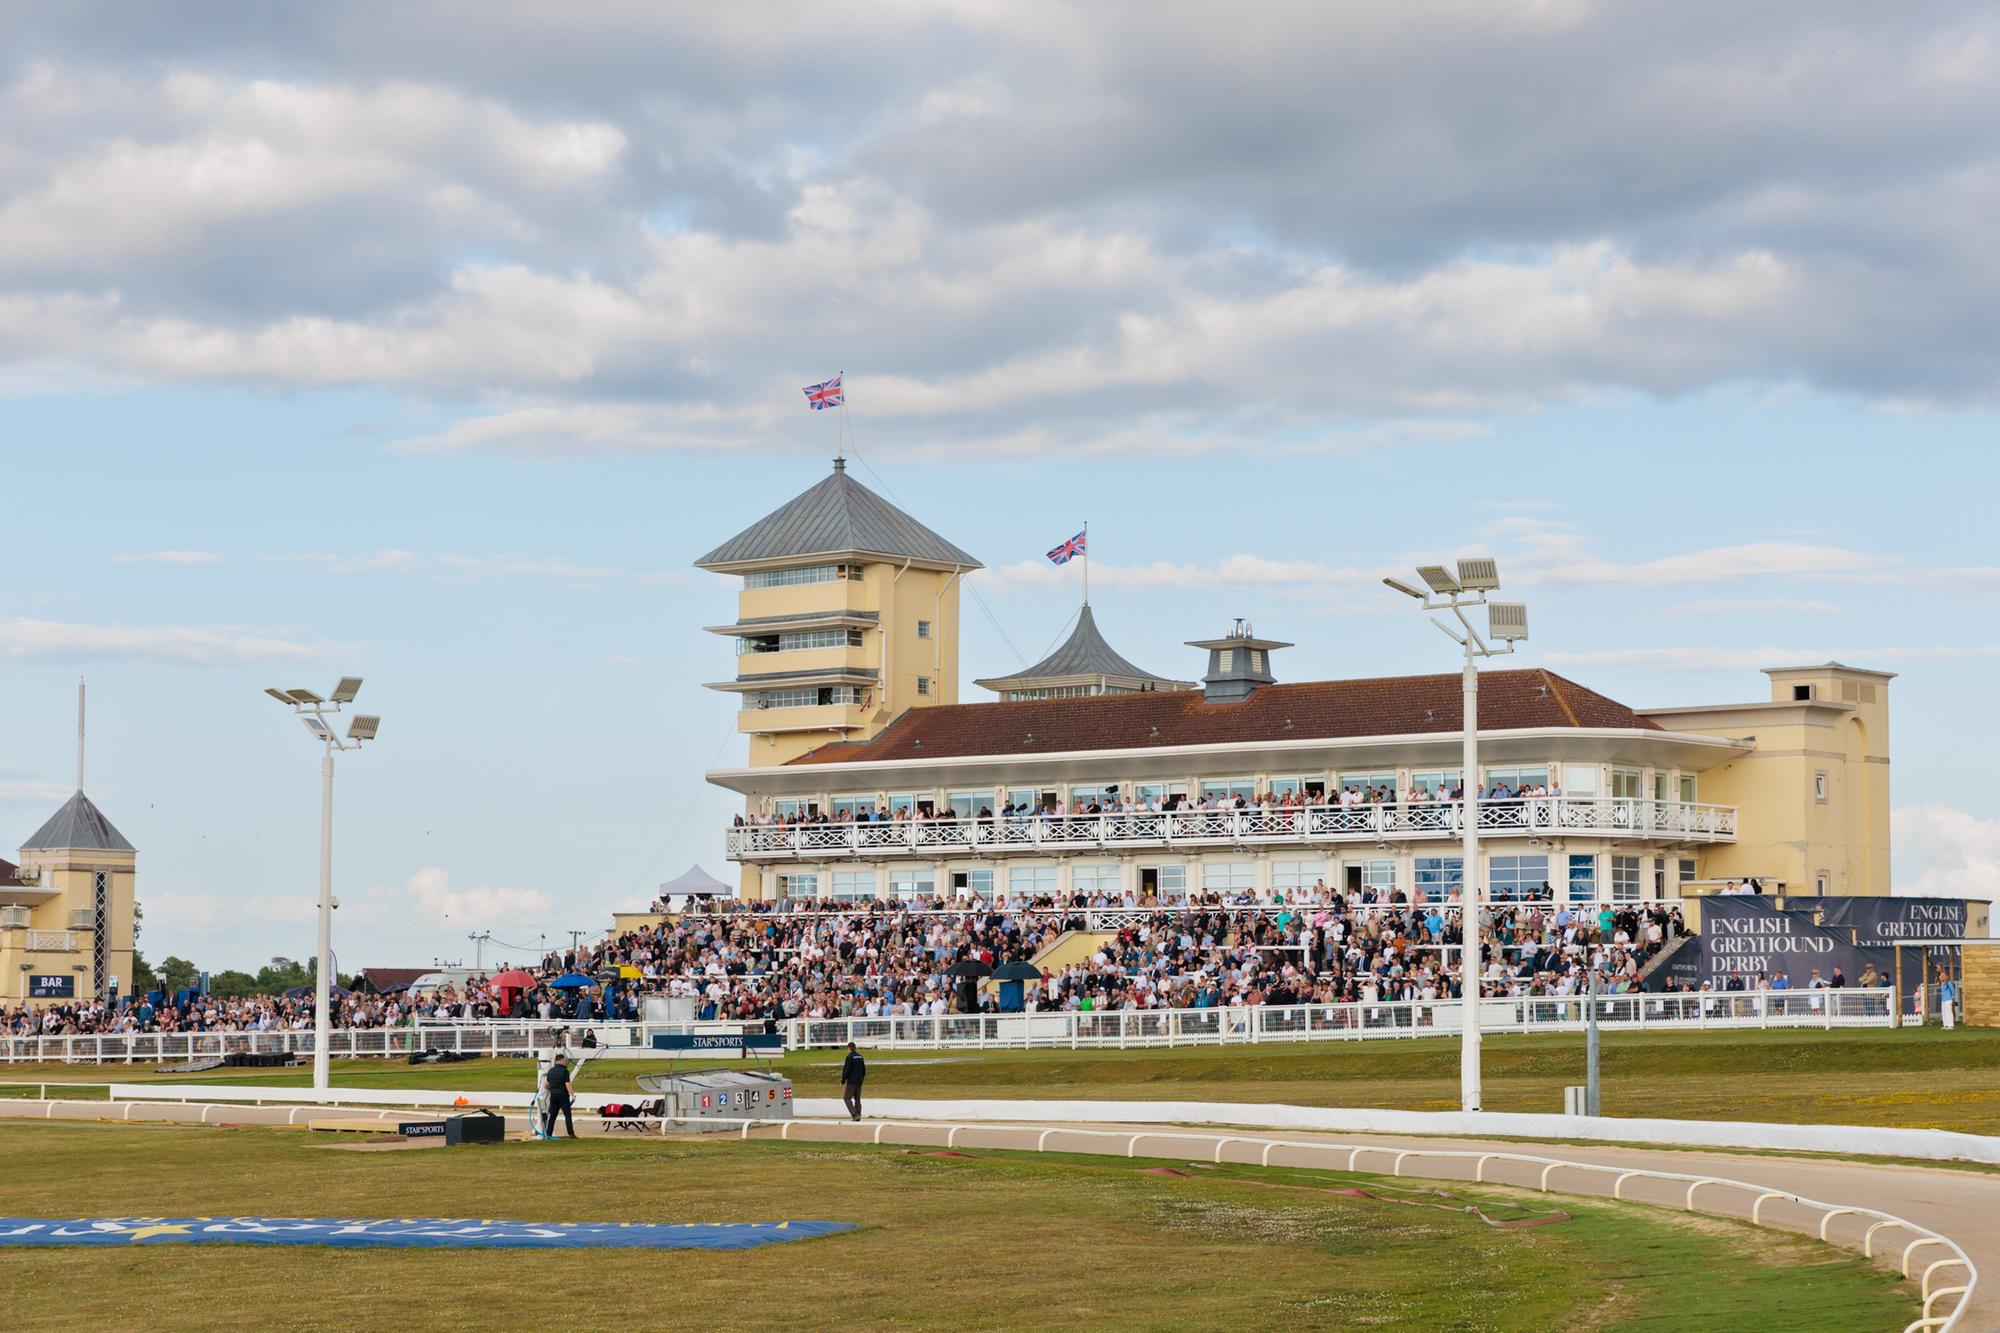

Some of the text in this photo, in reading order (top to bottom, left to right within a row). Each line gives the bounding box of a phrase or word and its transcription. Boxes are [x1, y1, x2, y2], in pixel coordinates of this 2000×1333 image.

[1710, 918, 1790, 934] ENGLISH
[1877, 922, 1965, 937] GREYHOUND
[1710, 936, 1834, 953] GREYHOUND
[1711, 956, 1771, 972] DERBY
[41, 977, 62, 987] BAR
[720, 1095, 727, 1105] 2
[736, 1093, 743, 1103] 3
[752, 1091, 760, 1102] 4
[768, 1089, 775, 1100] 5
